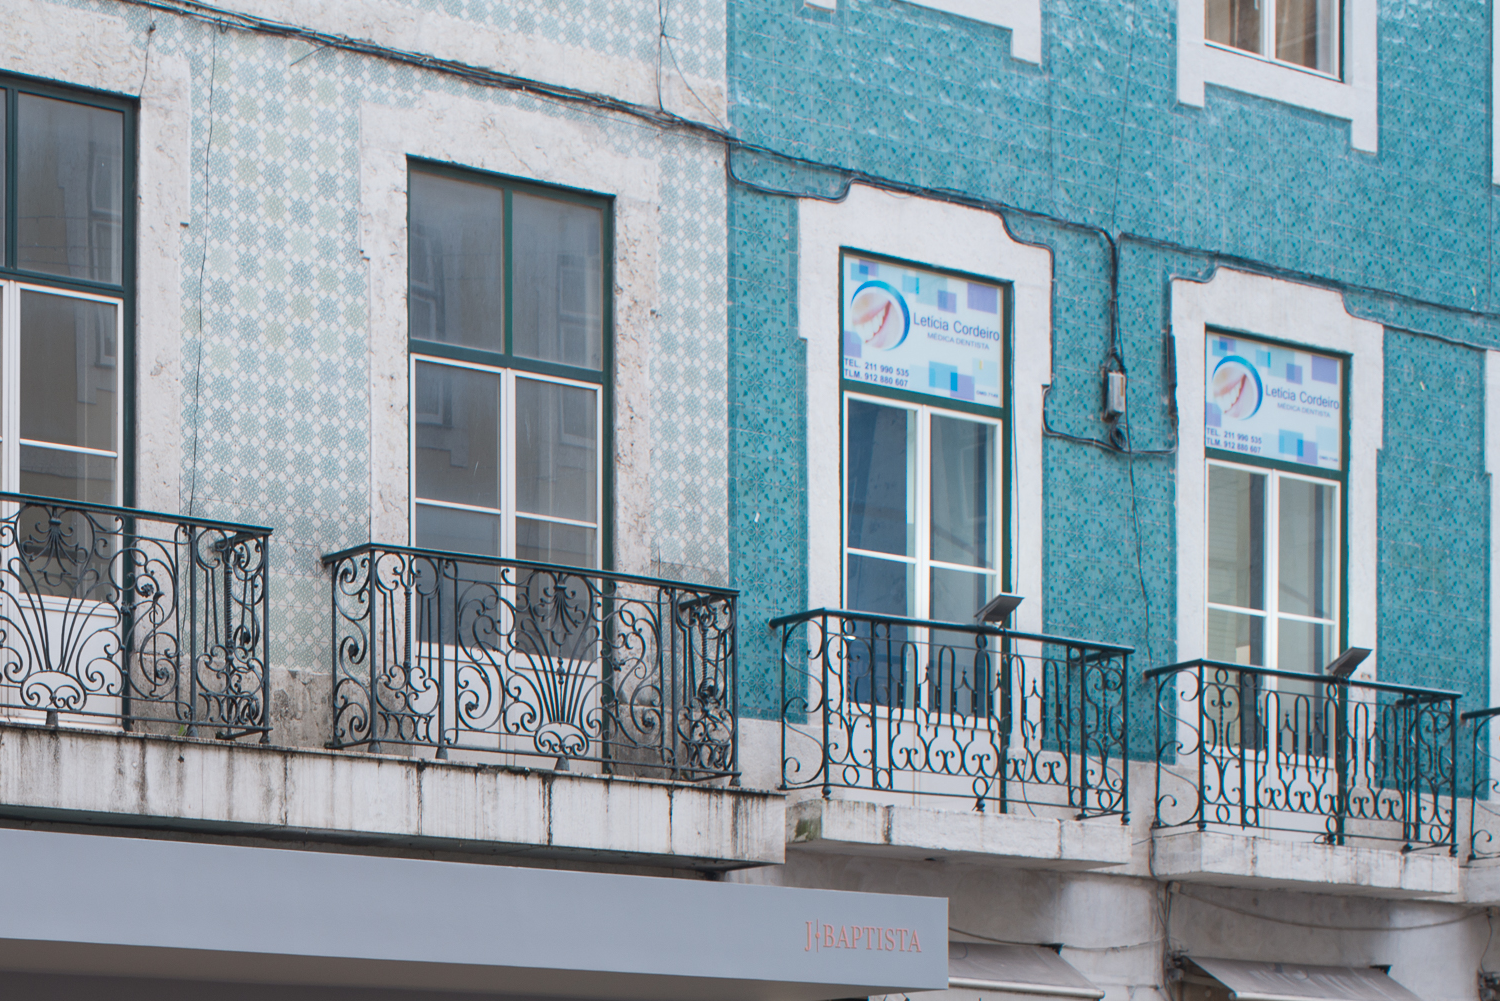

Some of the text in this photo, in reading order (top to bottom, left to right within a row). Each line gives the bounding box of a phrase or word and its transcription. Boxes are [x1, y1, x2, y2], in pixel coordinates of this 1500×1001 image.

[913, 312, 1000, 342] Letícia Cordeiro
[927, 332, 990, 350] MÉDICA DENTISTA
[844, 358, 909, 377] TEL. 211 990 535
[844, 369, 908, 387] TLM. 912 880 607
[1265, 384, 1340, 410] Letícia Cordeiro
[1302, 407, 1331, 418] DENTISTA
[1224, 431, 1235, 439] 211
[1237, 434, 1248, 442] 990
[1251, 436, 1262, 444] 535
[1224, 440, 1235, 449] 912
[1237, 443, 1248, 452] 880
[1250, 445, 1261, 454] 607
